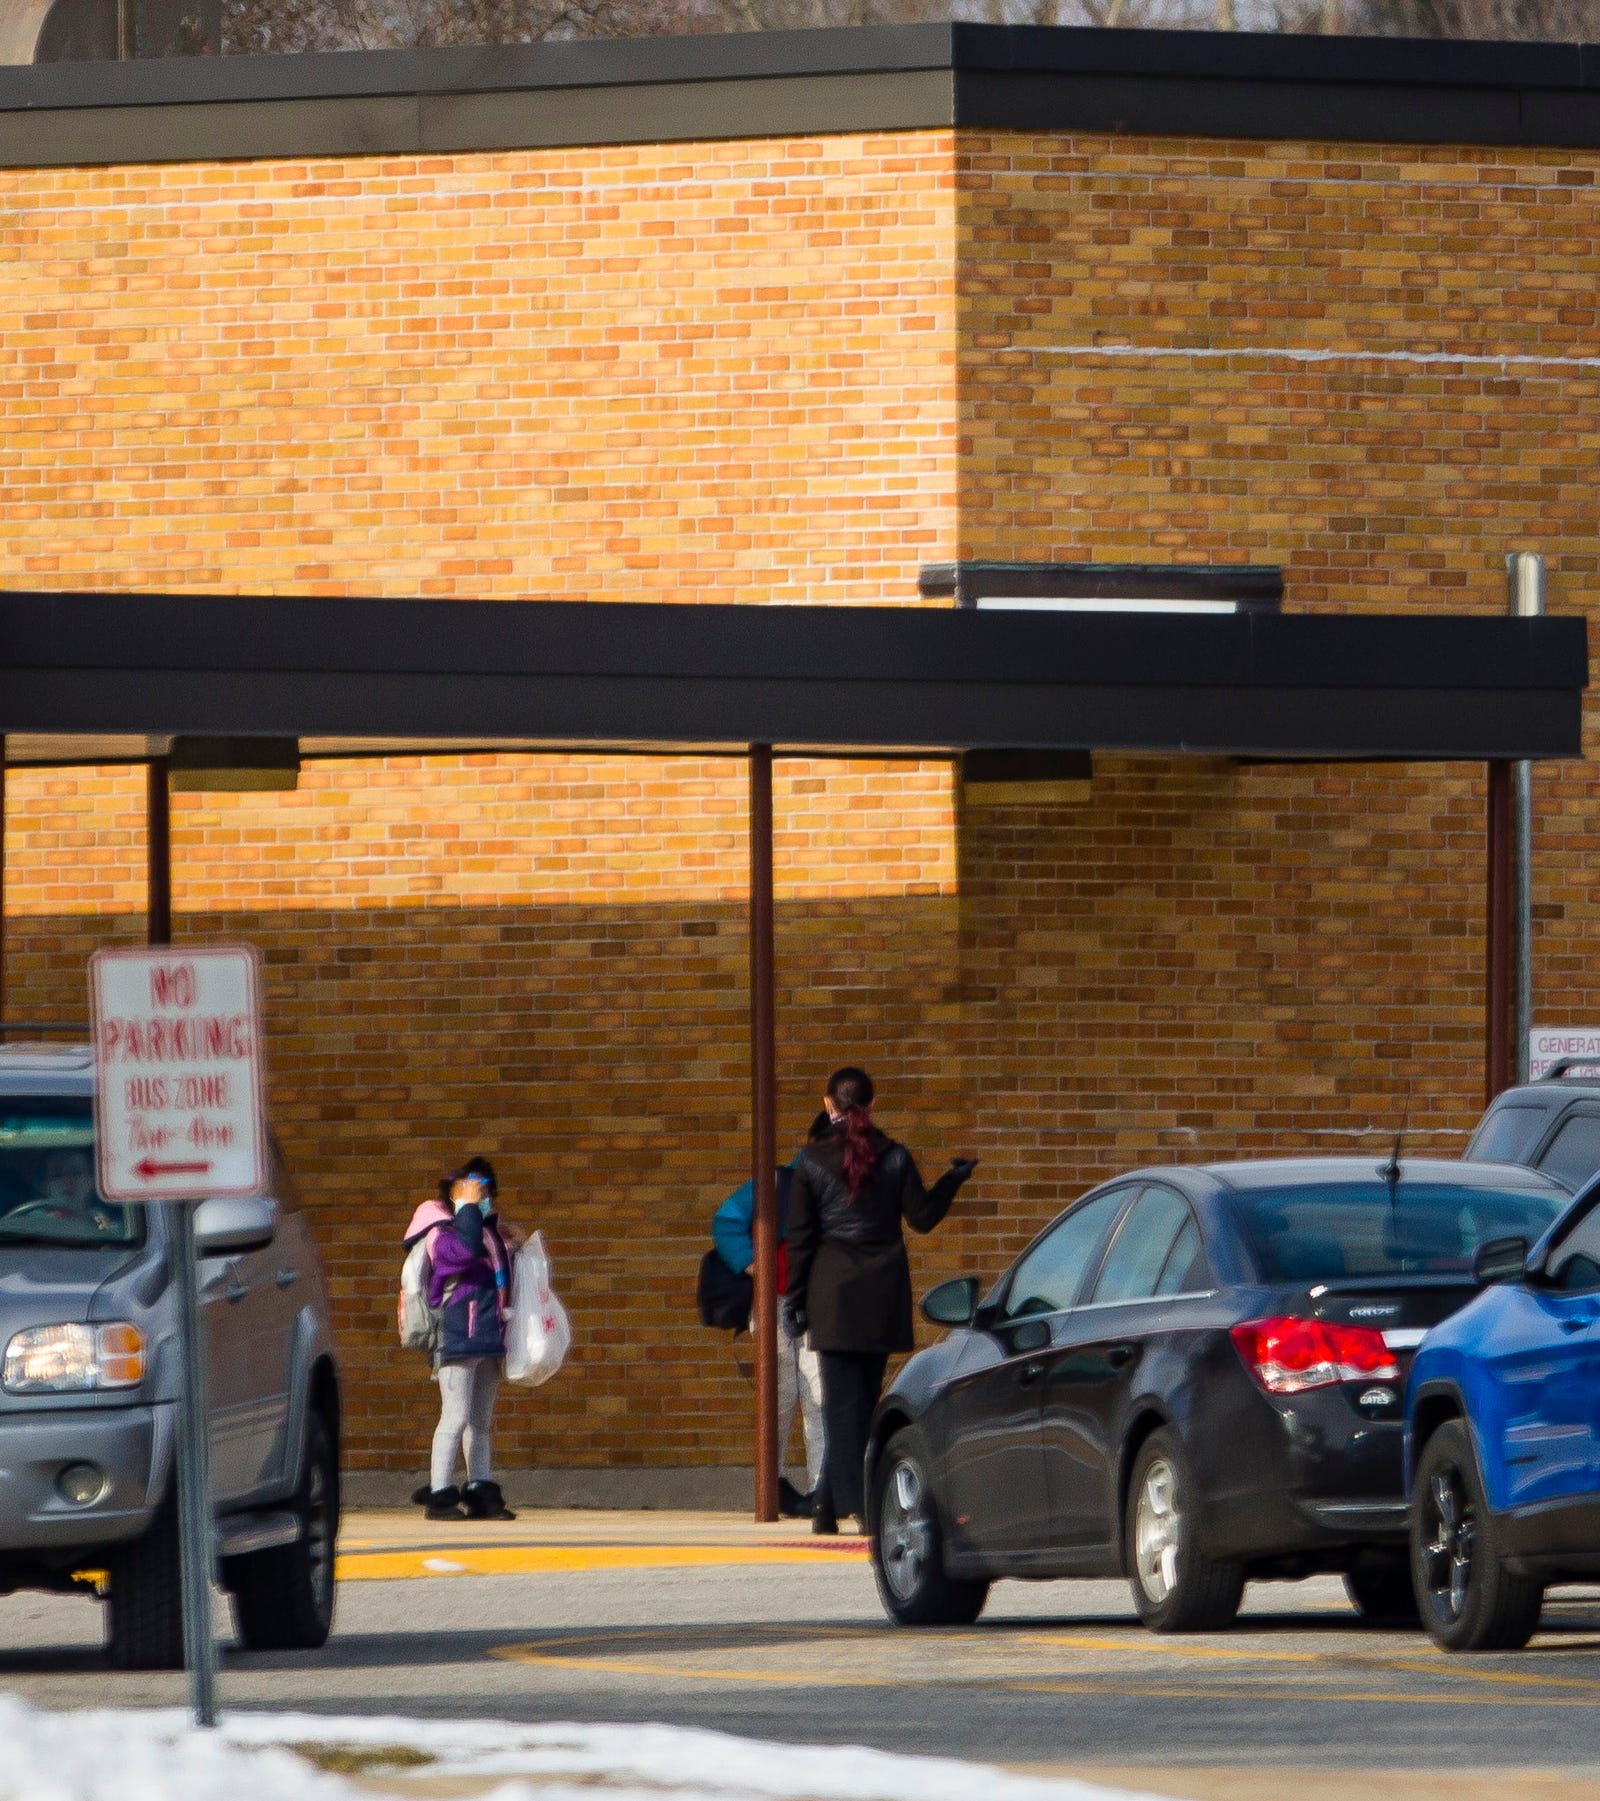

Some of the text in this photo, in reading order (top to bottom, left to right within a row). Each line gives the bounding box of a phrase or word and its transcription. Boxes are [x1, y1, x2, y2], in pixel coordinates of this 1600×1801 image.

[152, 965, 195, 1008] NO
[104, 1016, 250, 1061] PARKING
[125, 1074, 227, 1110] BUS ZONE
[1360, 1395, 1390, 1405] GATES
